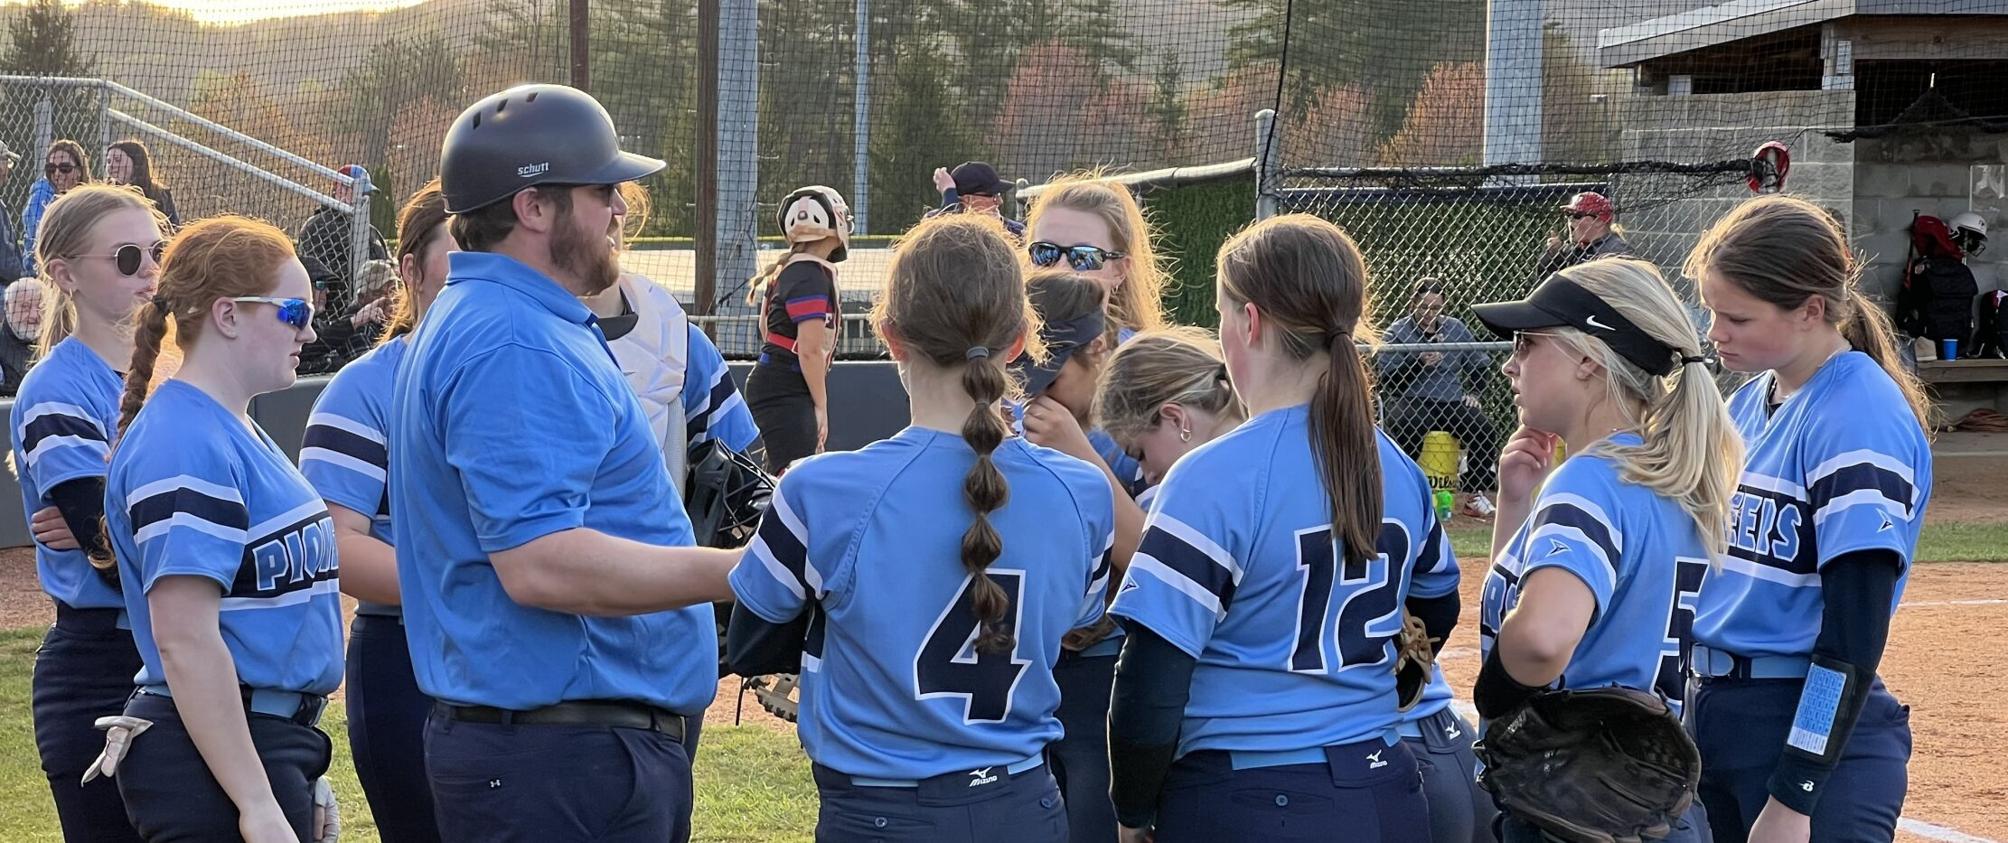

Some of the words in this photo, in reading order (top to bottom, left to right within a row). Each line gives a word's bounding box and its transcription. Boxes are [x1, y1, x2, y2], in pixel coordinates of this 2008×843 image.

[517, 162, 549, 176] schutt
[913, 568, 1033, 726] 4
[1287, 517, 1411, 675] 12
[1649, 556, 1710, 706] 5
